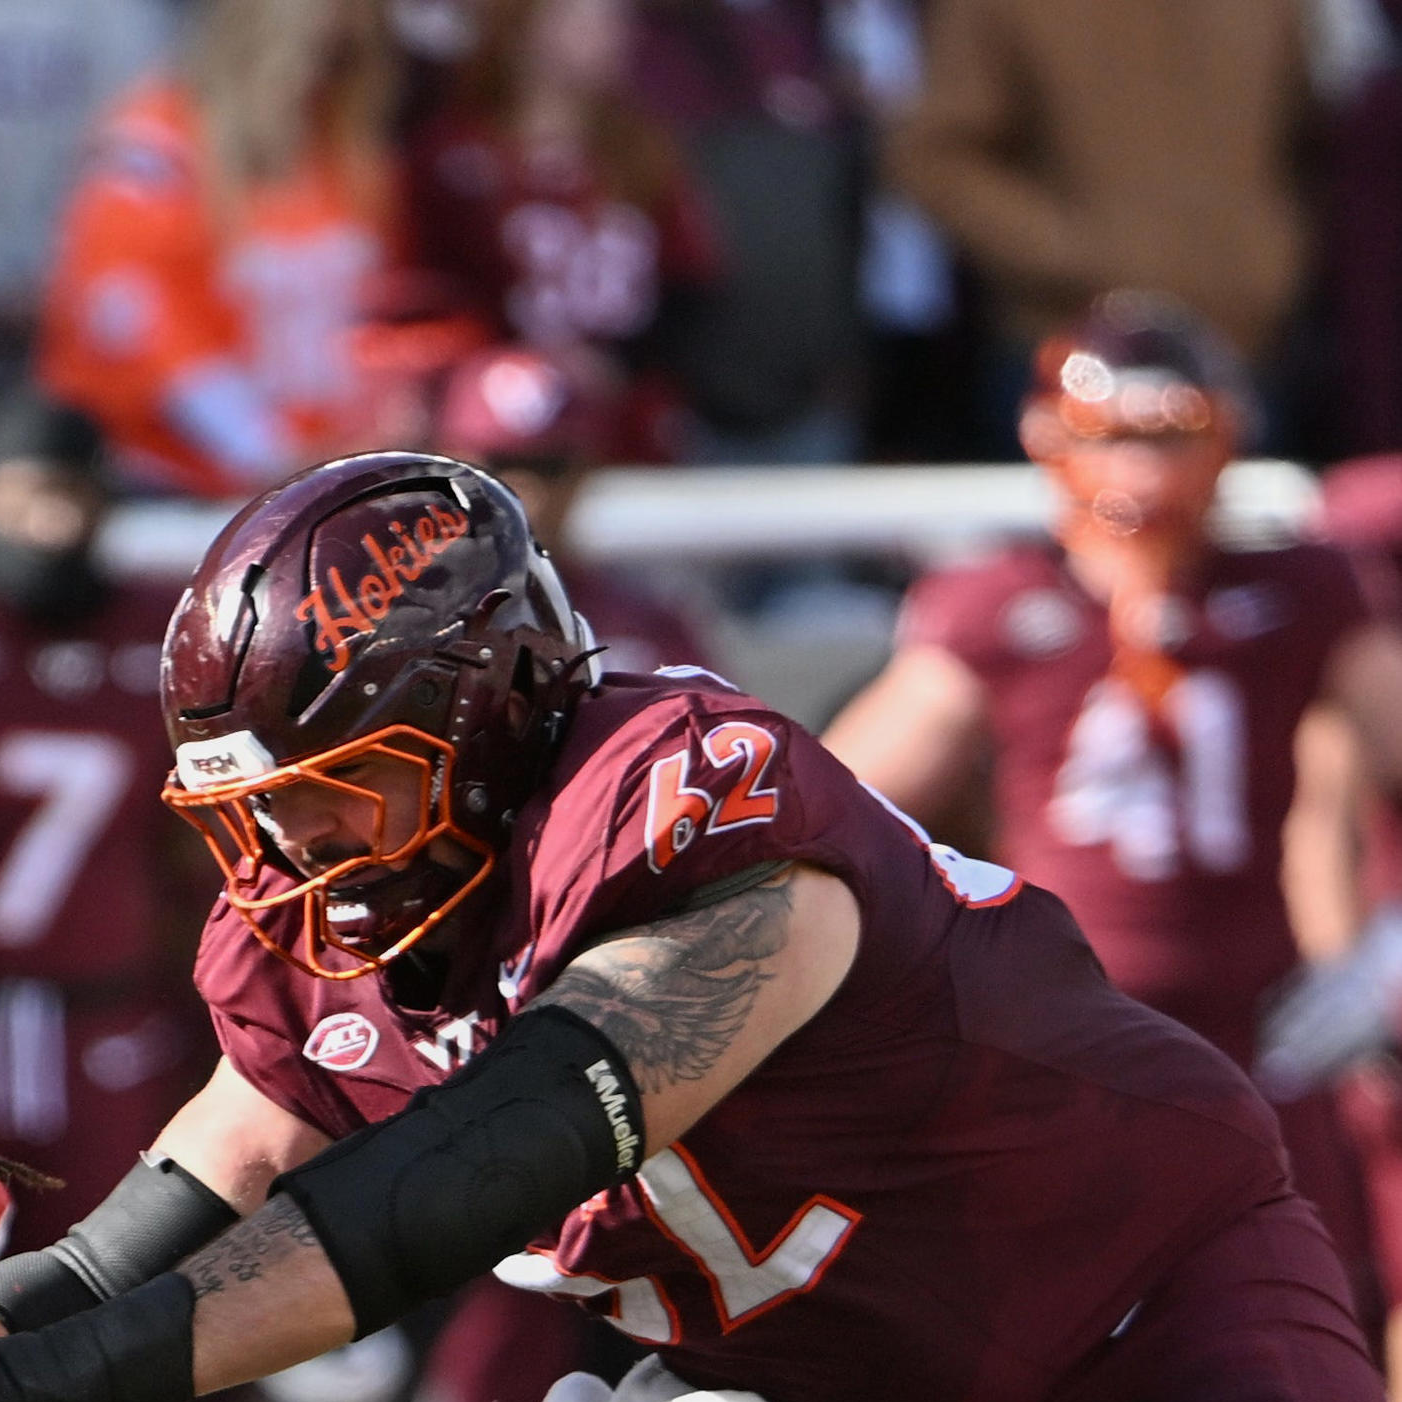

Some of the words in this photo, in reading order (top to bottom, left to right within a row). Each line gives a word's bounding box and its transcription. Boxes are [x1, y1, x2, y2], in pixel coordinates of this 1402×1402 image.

[296, 503, 471, 672] Hokies
[644, 721, 779, 874] 62
[413, 1010, 479, 1072] VT
[595, 1073, 640, 1169] Mueller
